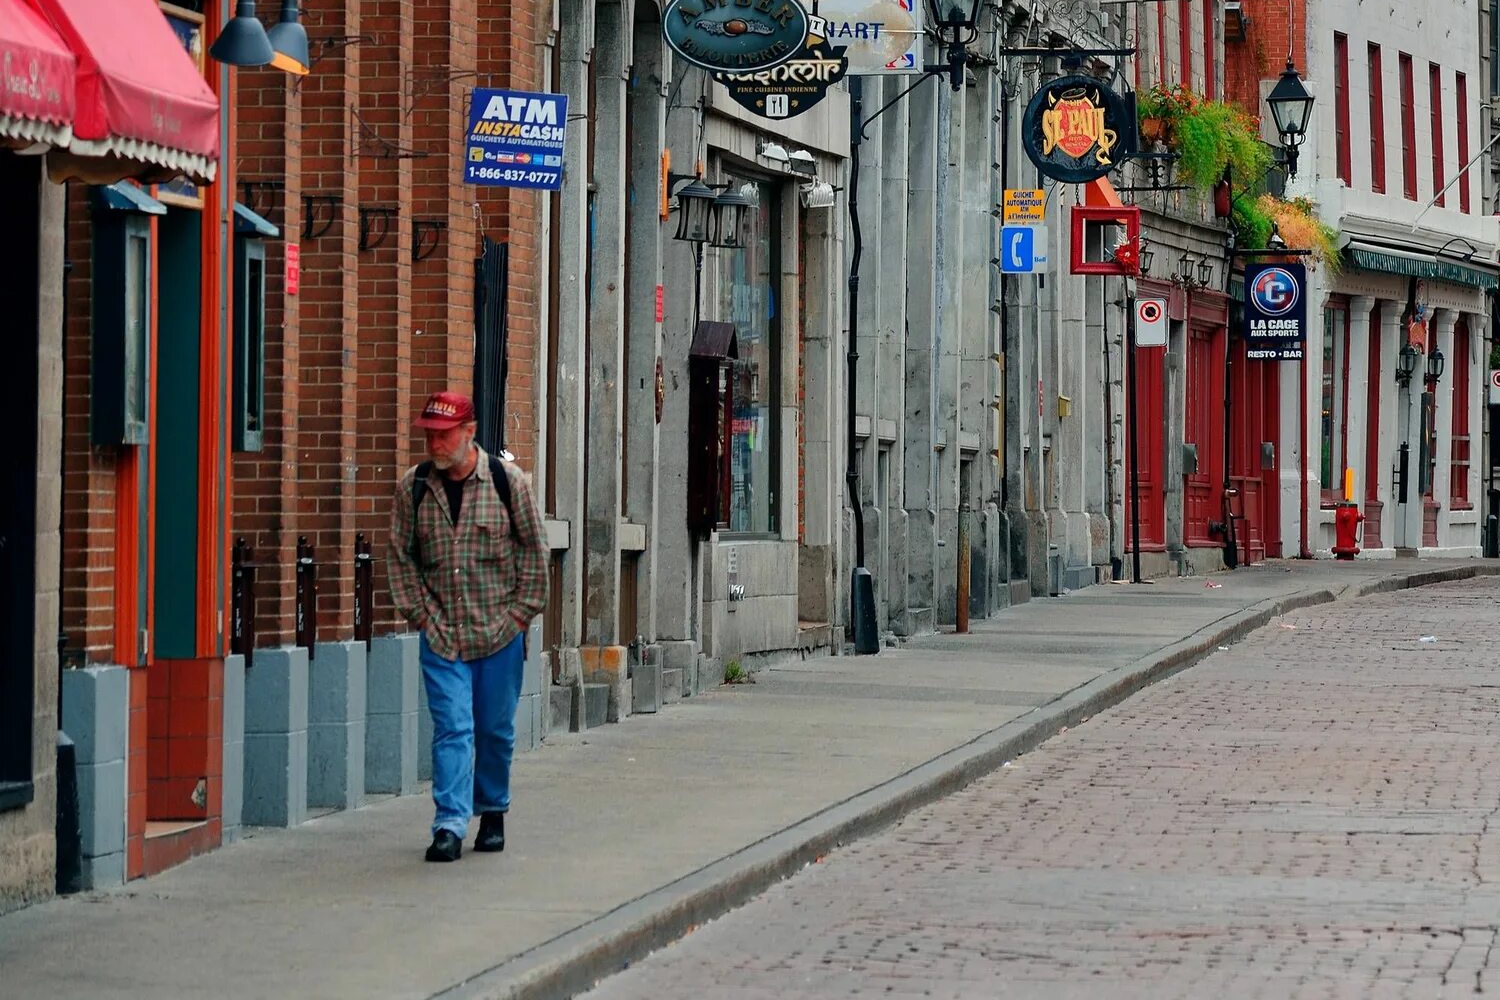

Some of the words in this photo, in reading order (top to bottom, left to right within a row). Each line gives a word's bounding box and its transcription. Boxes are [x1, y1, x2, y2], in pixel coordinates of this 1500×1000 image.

[680, 37, 789, 65] BIJOUTERIE
[482, 95, 557, 125] ATM
[1068, 107, 1109, 155] PAUL
[470, 134, 506, 144] GUICHETS
[506, 137, 563, 148] AUTOMATIQUES
[469, 166, 557, 184] 1-866-837-0777
[1250, 319, 1266, 330] LA
[1267, 319, 1299, 330] CAGE
[1247, 350, 1276, 358] RESTO
[1283, 350, 1302, 358] BAR
